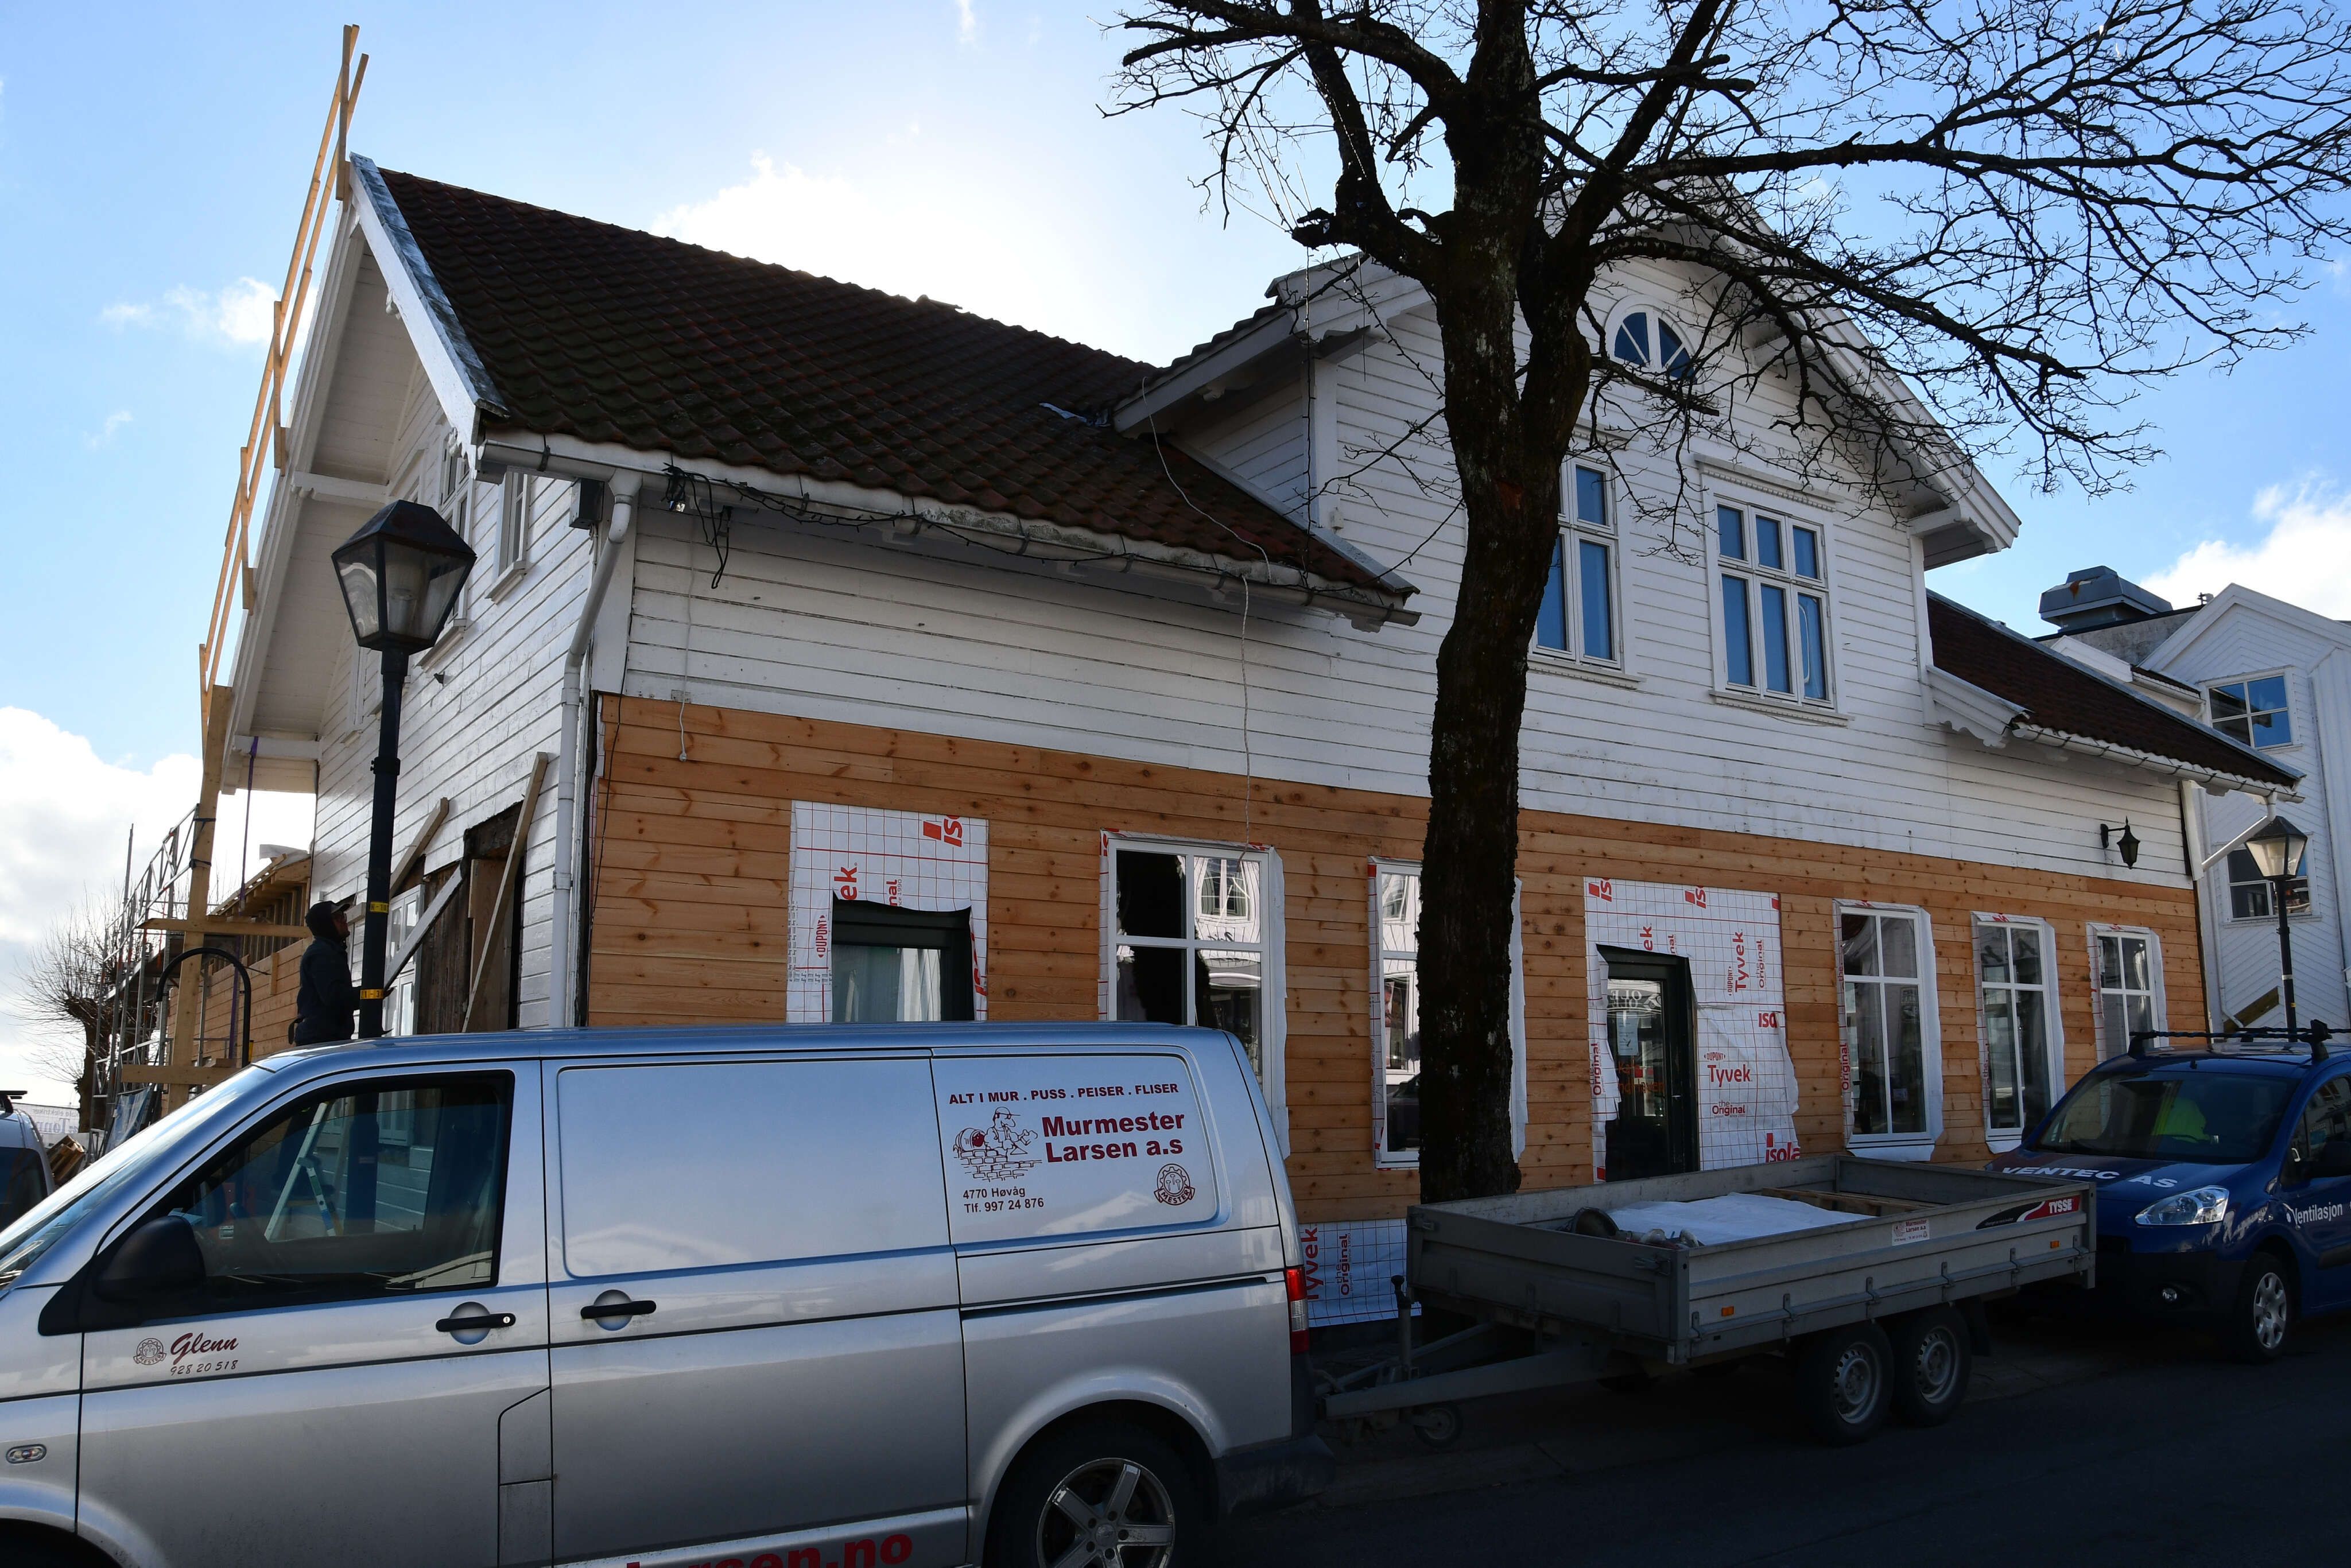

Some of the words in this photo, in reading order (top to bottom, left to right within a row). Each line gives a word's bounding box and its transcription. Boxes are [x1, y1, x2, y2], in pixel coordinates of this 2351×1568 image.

[816, 919, 828, 953] DUPONT
[1732, 932, 1749, 992] Tyvek
[1756, 940, 1764, 988] Original
[1706, 1052, 1723, 1061] DUPONT
[1840, 1043, 1850, 1090] Original
[1591, 1043, 1601, 1095] Original
[1708, 1065, 1750, 1087] Tyvek
[949, 1093, 974, 1104] ALT
[979, 1093, 984, 1103] I
[988, 1091, 1019, 1102] MUR
[1031, 1089, 1066, 1100] PUSS
[1078, 1086, 1124, 1097] PEISER
[1135, 1083, 1179, 1094] FLISER
[1712, 1104, 1745, 1116] Original
[1042, 1111, 1184, 1137] Murmester
[1046, 1141, 1138, 1162] Larsen
[1146, 1139, 1183, 1156] a.s
[2002, 1166, 2121, 1179] VENTEC
[2127, 1175, 2178, 1188] AS
[963, 1189, 987, 1199] 4770
[992, 1186, 1025, 1197] Høvåg
[1161, 1190, 1190, 1204] MESTER
[964, 1202, 981, 1213] Tlf.
[984, 1201, 1003, 1212] 997
[1008, 1200, 1021, 1210] 24
[1025, 1198, 1044, 1208] 876
[2048, 1198, 2073, 1213] TYSSE
[2292, 1201, 2343, 1225] Ventilasjon
[1339, 1234, 1349, 1295] Original
[170, 1332, 239, 1365] Glenn
[170, 1364, 192, 1376] 928
[196, 1363, 212, 1372] 20
[215, 1360, 239, 1371] 518
